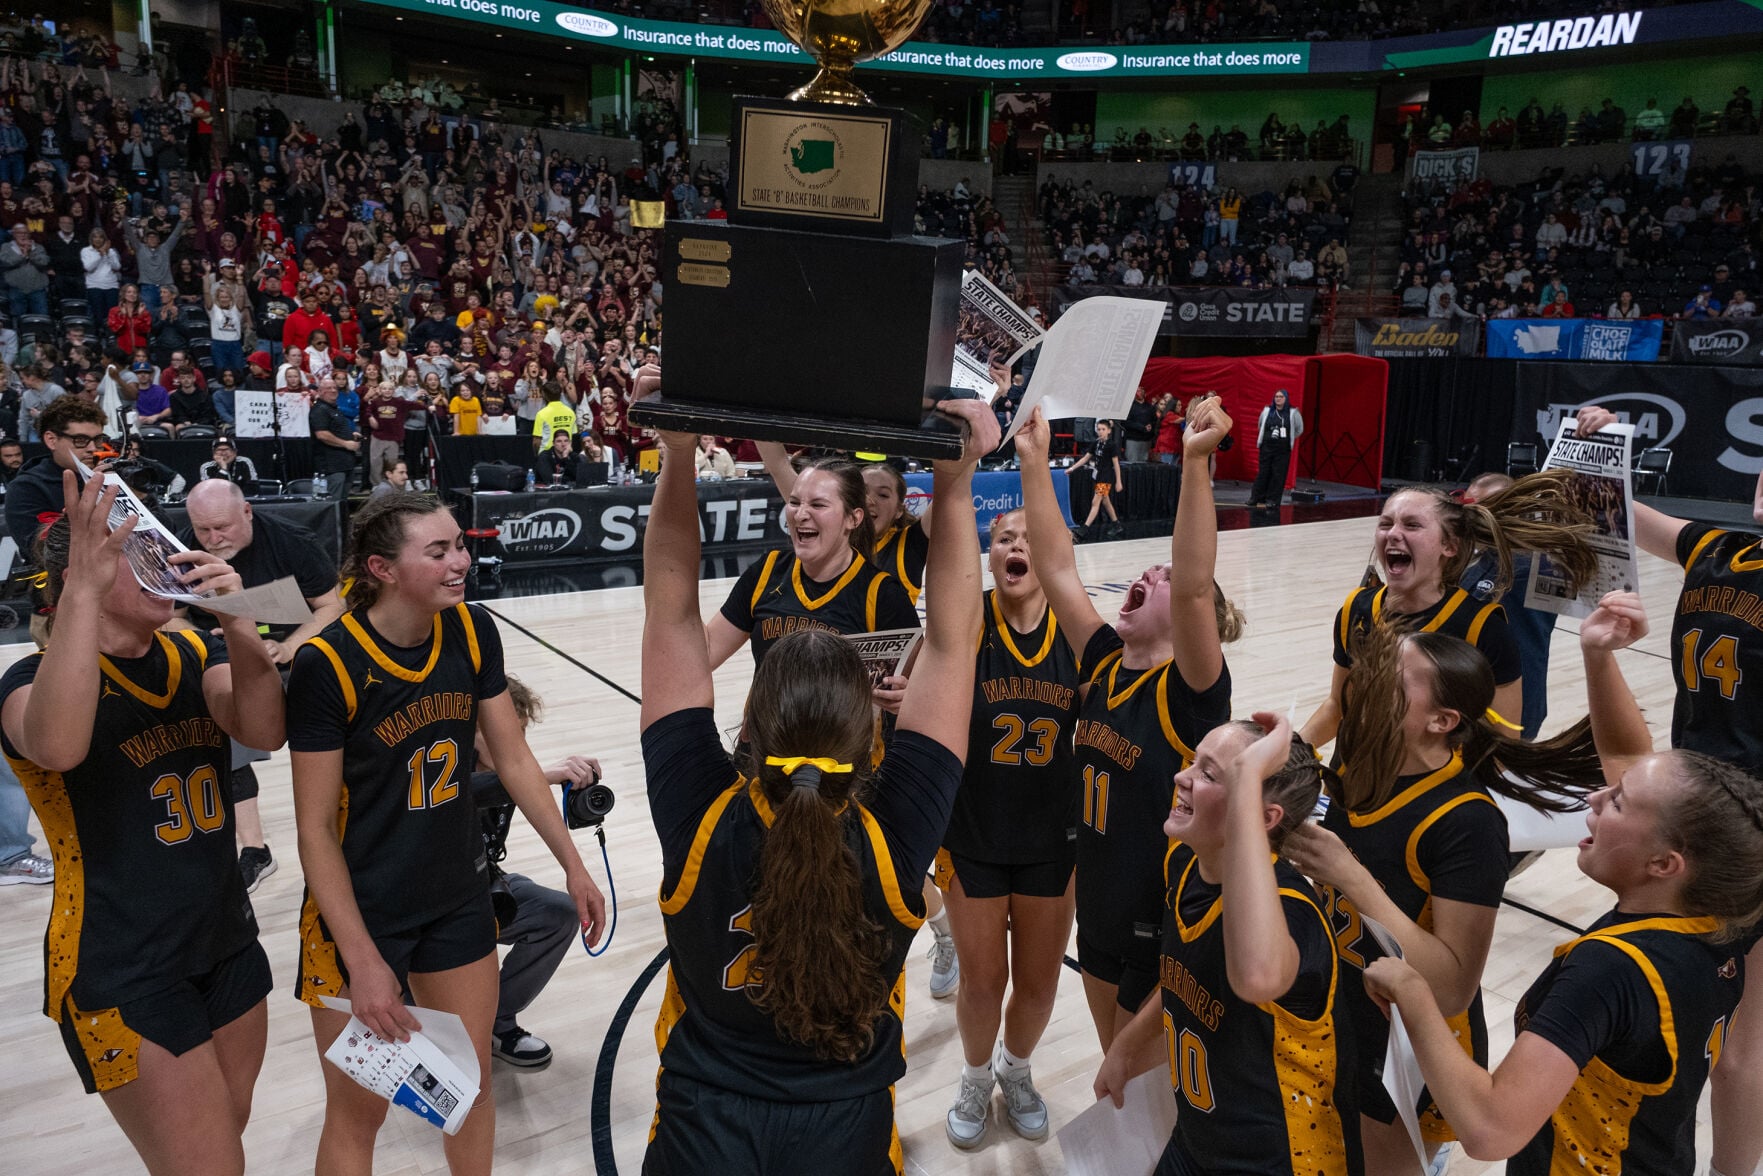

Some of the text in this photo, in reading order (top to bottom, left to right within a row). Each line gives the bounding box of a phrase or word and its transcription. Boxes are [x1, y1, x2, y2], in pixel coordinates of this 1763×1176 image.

[460, 0, 498, 15] does
[501, 5, 541, 22] more
[565, 14, 610, 31] COUNTRY
[624, 25, 800, 54] Insurance that does more
[1489, 11, 1642, 57] REARDAN
[879, 51, 1044, 70] nsurance that does more
[1065, 55, 1109, 64] COUNTRY
[1123, 51, 1301, 68] Insurance that does more
[1417, 157, 1473, 177] DICKS
[1634, 143, 1690, 176] 123
[1172, 166, 1215, 190] 124
[752, 188, 771, 201] STATE
[785, 192, 828, 209] BASKETBALL
[831, 195, 870, 212] CHAMPIONS
[964, 281, 996, 308] STATE
[992, 302, 1036, 342] CHAMPS!
[1226, 303, 1304, 322] STATE
[1372, 324, 1460, 346] Baden
[1592, 328, 1628, 340] CHOC
[1699, 336, 1739, 350] WIAA
[1589, 348, 1623, 360] MILK
[1553, 440, 1578, 461] STATE
[1576, 442, 1624, 468] CHAMPS!
[973, 493, 1013, 511] Credit
[511, 519, 569, 541] WIAA
[600, 499, 768, 551] STE
[855, 640, 910, 653] HAMPS!
[1682, 628, 1742, 700] 14
[982, 677, 1075, 711] WARRIORS
[373, 692, 473, 748] WARRIORS
[991, 713, 1061, 766] 23
[408, 738, 459, 811] 12
[150, 763, 225, 846] 30
[1083, 764, 1110, 835] 11
[1159, 954, 1225, 1032] RRIORS
